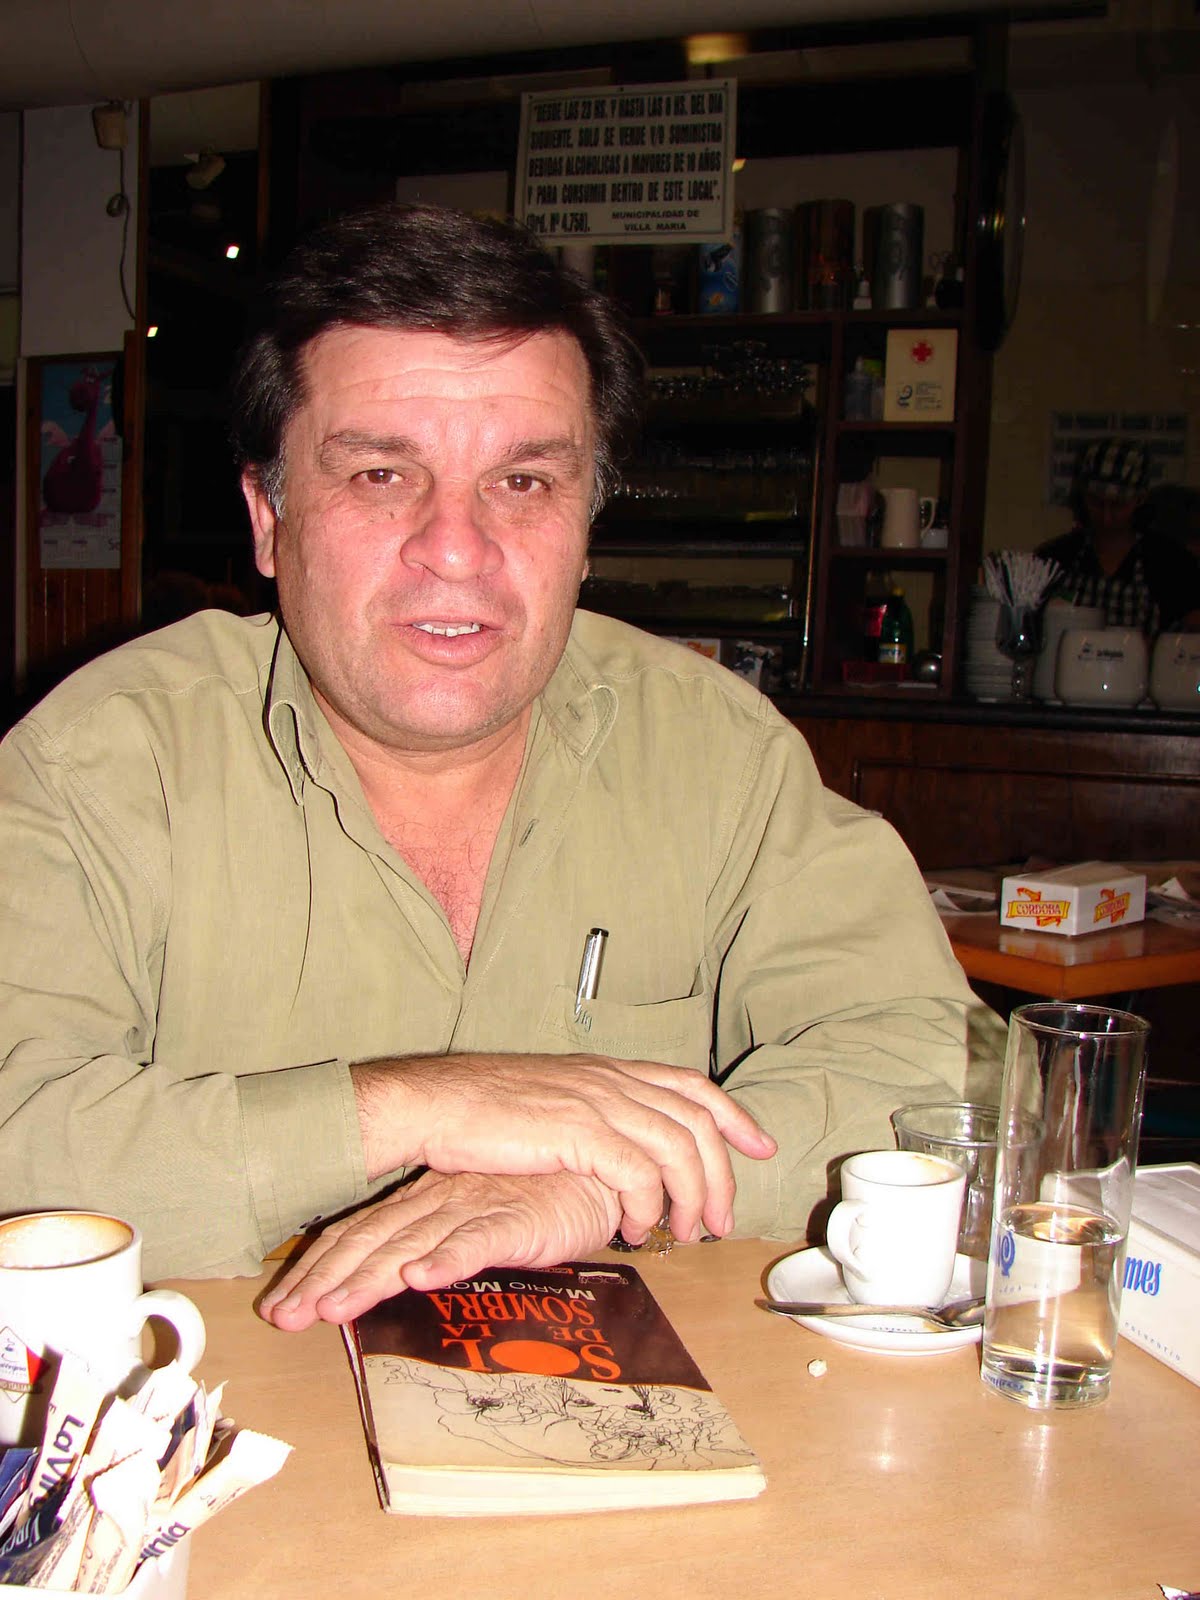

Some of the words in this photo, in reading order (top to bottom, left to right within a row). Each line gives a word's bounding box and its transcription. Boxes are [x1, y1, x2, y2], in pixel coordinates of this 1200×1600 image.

[564, 100, 578, 120] LAS
[611, 98, 617, 118] Y
[619, 96, 645, 118] HASTA
[648, 95, 663, 117] LAS
[691, 93, 706, 115] DEL
[604, 126, 615, 146] SE
[619, 125, 646, 146] VENDE
[669, 122, 722, 144] SUMINISTRA
[565, 154, 620, 175] ALCOHOLICAS
[623, 153, 630, 174] A
[631, 152, 671, 173] MAYORES
[673, 151, 684, 172] DE
[698, 147, 721, 171] AÑOS
[527, 186, 533, 205] Y
[536, 185, 557, 205] PARA
[562, 183, 606, 204] CONSUMIR
[612, 182, 643, 202] DENTRO
[648, 181, 658, 202] DE
[663, 180, 683, 202] ESTE
[612, 209, 684, 220] MUNICIPALIDAD
[687, 208, 700, 218] DE
[624, 223, 652, 232] VILLA
[1017, 903, 1062, 915] CORDOBA
[1122, 1256, 1162, 1296] mes
[509, 1281, 597, 1301] MARIO
[426, 1293, 595, 1325] SOMBRA
[440, 1323, 496, 1338] LA
[548, 1325, 608, 1343] DE
